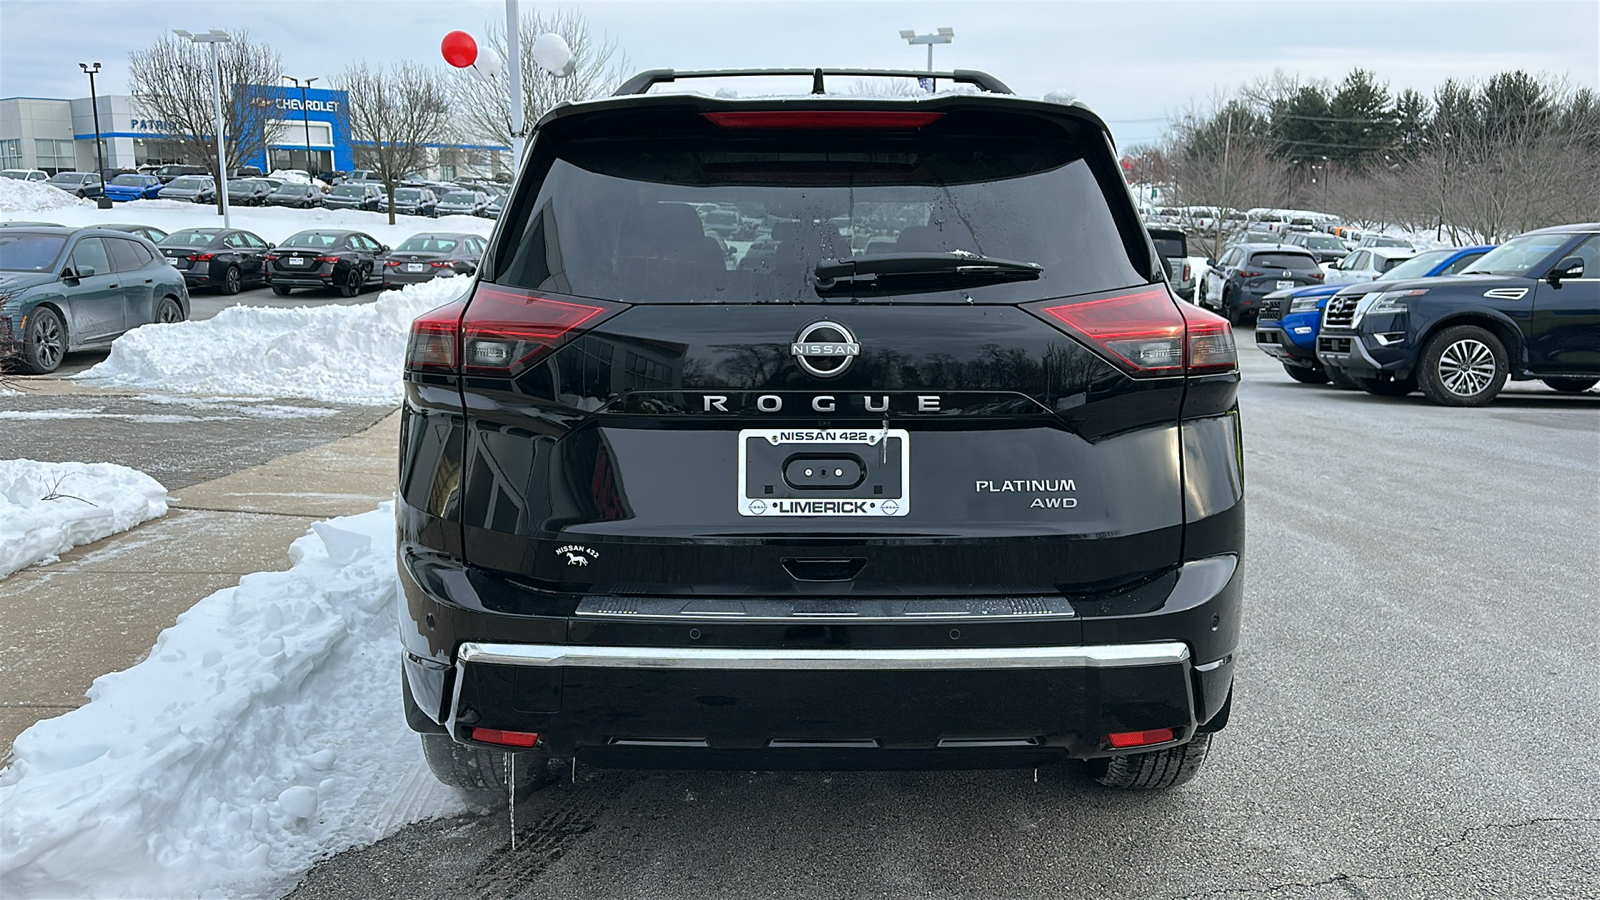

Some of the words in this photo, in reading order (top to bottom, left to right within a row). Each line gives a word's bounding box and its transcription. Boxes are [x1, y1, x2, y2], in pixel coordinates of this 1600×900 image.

[275, 98, 339, 112] CHEVROLET
[793, 345, 857, 354] NISSAN
[703, 394, 941, 412] ROGUE
[780, 432, 836, 441] NISSAN
[839, 432, 868, 441] 422
[976, 479, 1077, 492] PLATINUM
[779, 501, 867, 513] LIMERICK
[1029, 498, 1078, 508] AWD
[555, 544, 585, 555] NISSAN
[586, 547, 600, 559] 422
